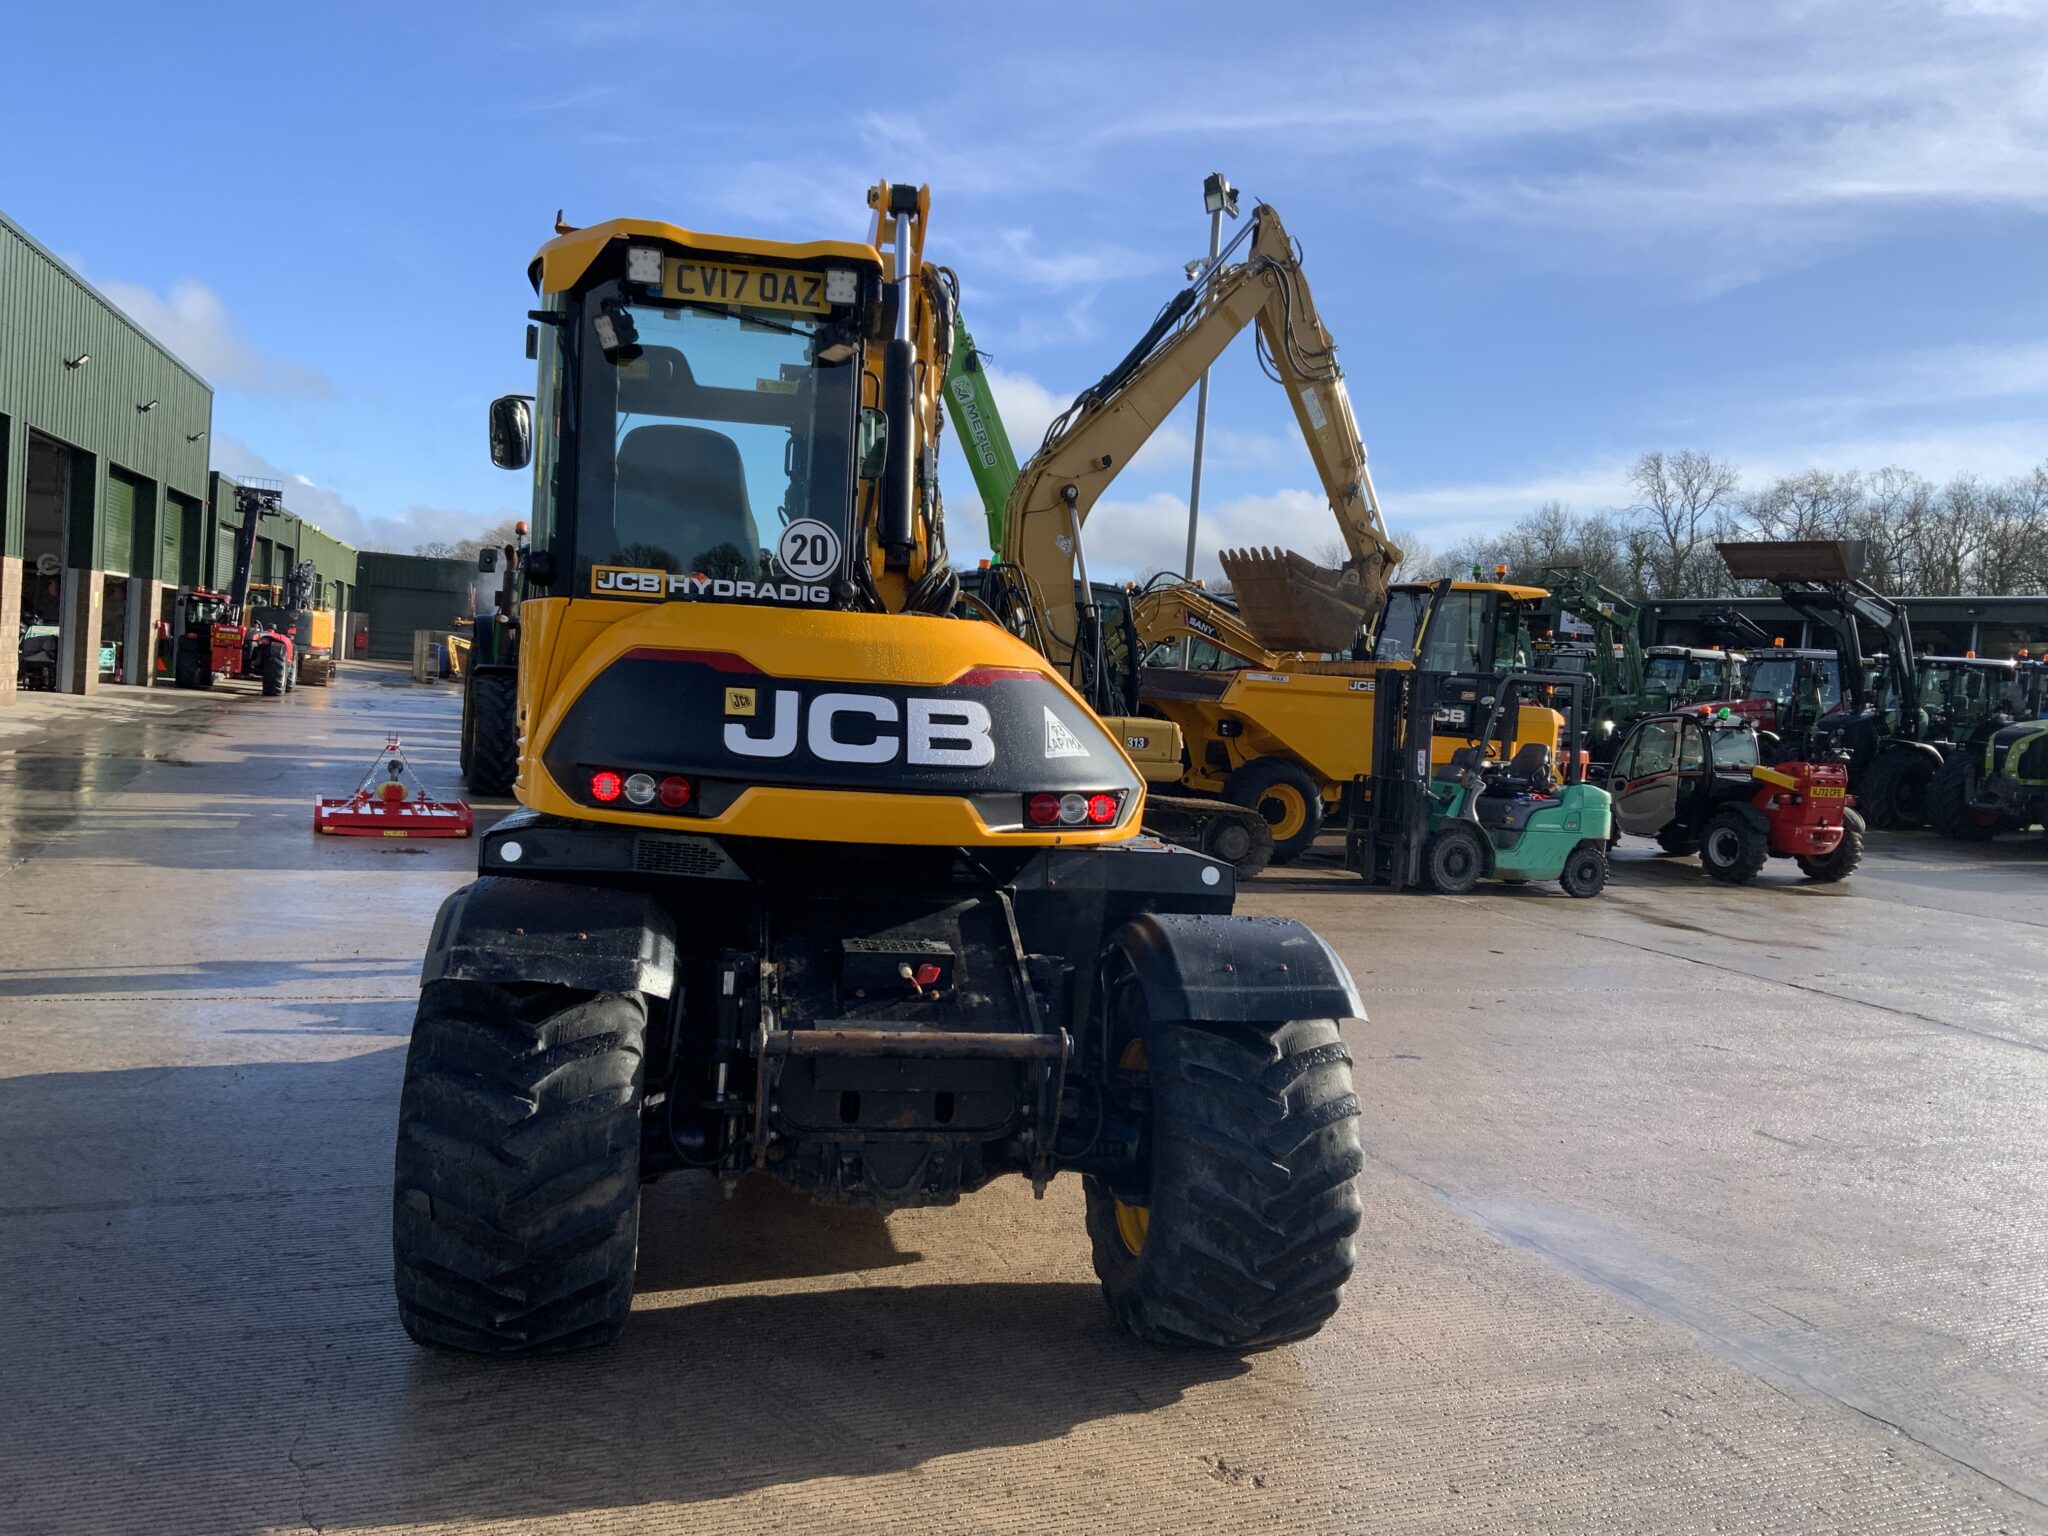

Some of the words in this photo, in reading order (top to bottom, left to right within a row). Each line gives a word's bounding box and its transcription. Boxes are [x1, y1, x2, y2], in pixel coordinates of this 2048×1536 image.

[677, 264, 749, 299] CV17
[759, 273, 822, 308] OAZ
[966, 403, 997, 467] MERLO
[790, 534, 828, 566] 20
[597, 571, 660, 593] JCB
[668, 575, 830, 604] HYDRADIG
[1188, 616, 1216, 636] SANY
[733, 694, 751, 708] JCB
[723, 689, 996, 767] JCB
[1434, 708, 1465, 723] CB
[1051, 725, 1066, 737] 93
[1127, 736, 1145, 749] 313
